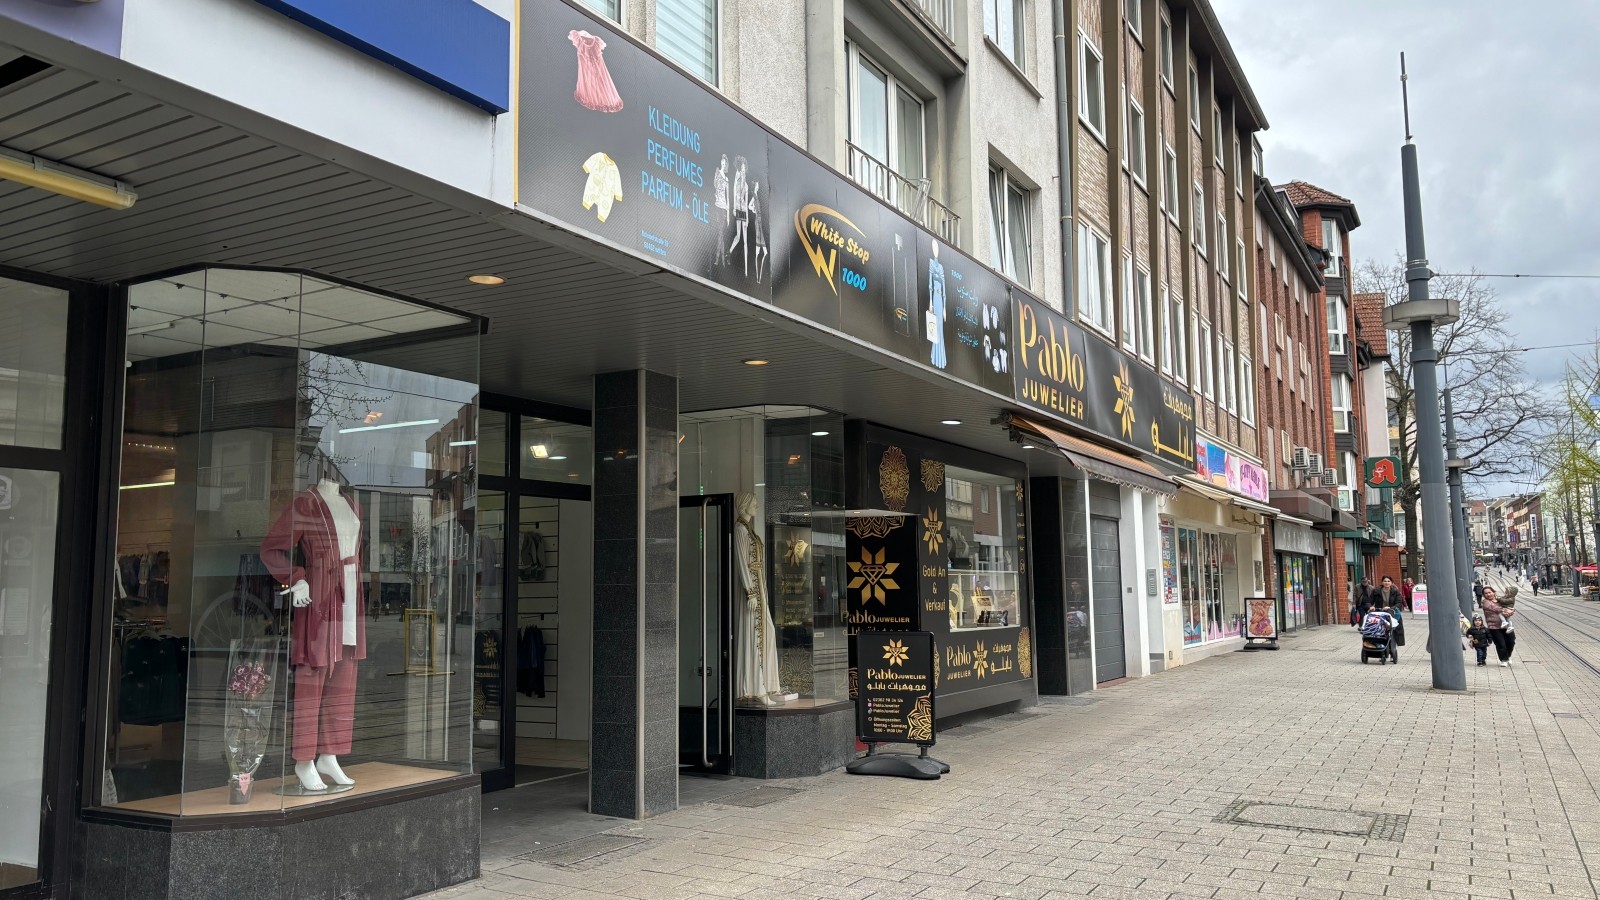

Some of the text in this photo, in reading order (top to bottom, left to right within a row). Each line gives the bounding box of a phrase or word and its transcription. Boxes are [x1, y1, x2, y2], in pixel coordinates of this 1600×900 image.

[648, 105, 701, 154] KLEIDUNG
[647, 138, 703, 188] PERFUMES
[641, 170, 683, 212] PARFUM
[692, 192, 709, 224] ÖLE
[810, 216, 870, 265] White Stop
[842, 267, 867, 291] 1000
[1018, 298, 1085, 393] Pablo
[1022, 383, 1084, 421] JUWELIER
[1163, 385, 1192, 421] مجوهرات
[1151, 416, 1194, 468] بابلو
[922, 564, 946, 577] Gold An
[932, 582, 938, 594] &
[840, 609, 875, 624] Pablo
[925, 599, 946, 612] Verkauf
[946, 644, 972, 668] Pablo
[866, 681, 927, 691] مجوهرات بابلو
[867, 668, 898, 680] Pablo
[947, 670, 972, 681] JUWELIER
